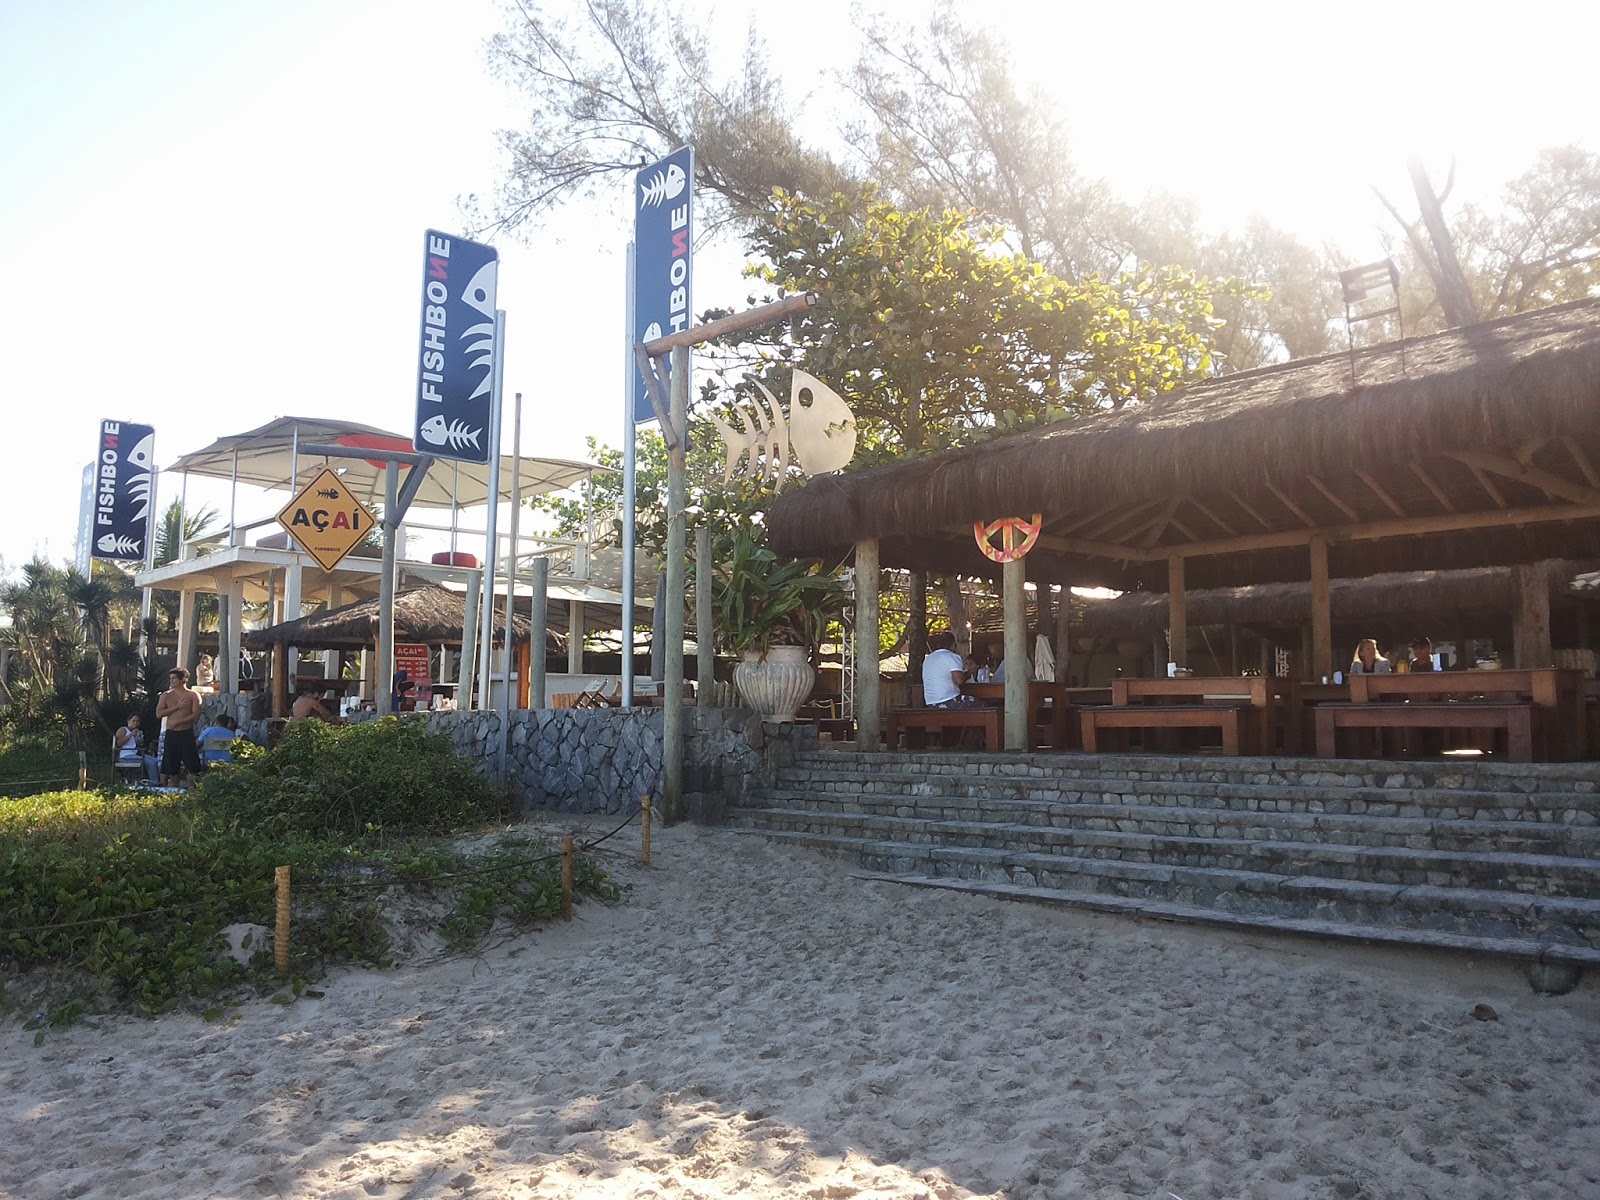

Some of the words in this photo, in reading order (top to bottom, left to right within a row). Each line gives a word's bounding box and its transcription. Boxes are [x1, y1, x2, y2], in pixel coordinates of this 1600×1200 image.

[422, 235, 451, 403] FISHBONE
[97, 421, 120, 525] FISHBONE
[291, 508, 359, 533] AÇAÍ
[985, 544, 1027, 561] PEACE
